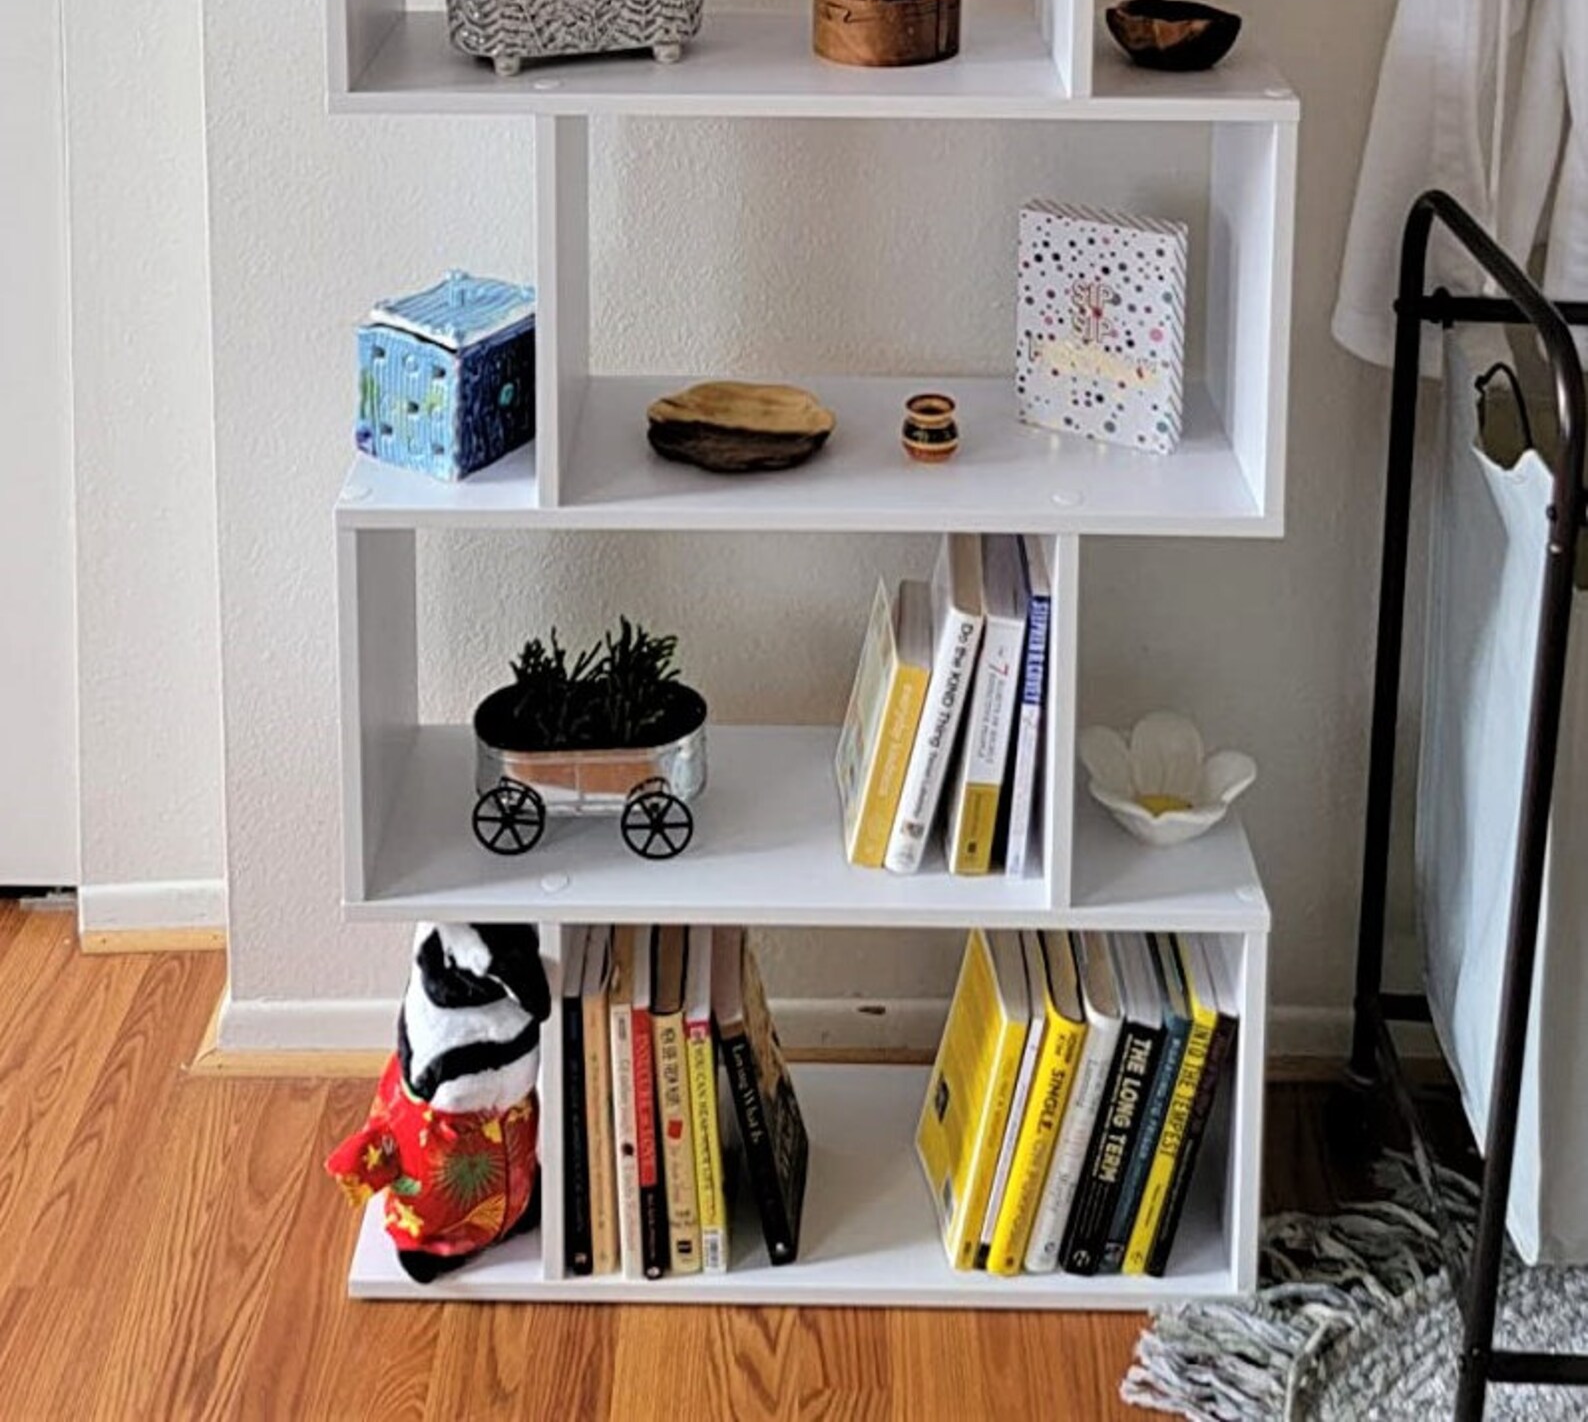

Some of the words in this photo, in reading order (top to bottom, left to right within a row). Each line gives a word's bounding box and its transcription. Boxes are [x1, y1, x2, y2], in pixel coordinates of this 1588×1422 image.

[956, 622, 974, 645] Do
[950, 644, 969, 669] the
[987, 661, 1010, 676] 7
[939, 669, 963, 709] KIND
[927, 709, 951, 749] Thing
[1125, 1035, 1153, 1075] THE
[1185, 1023, 1213, 1060] INTO
[1177, 1060, 1202, 1090] THE
[1110, 1076, 1141, 1130] LONG
[1157, 1091, 1193, 1159] TEMPEST
[1096, 1131, 1127, 1183] TERM
